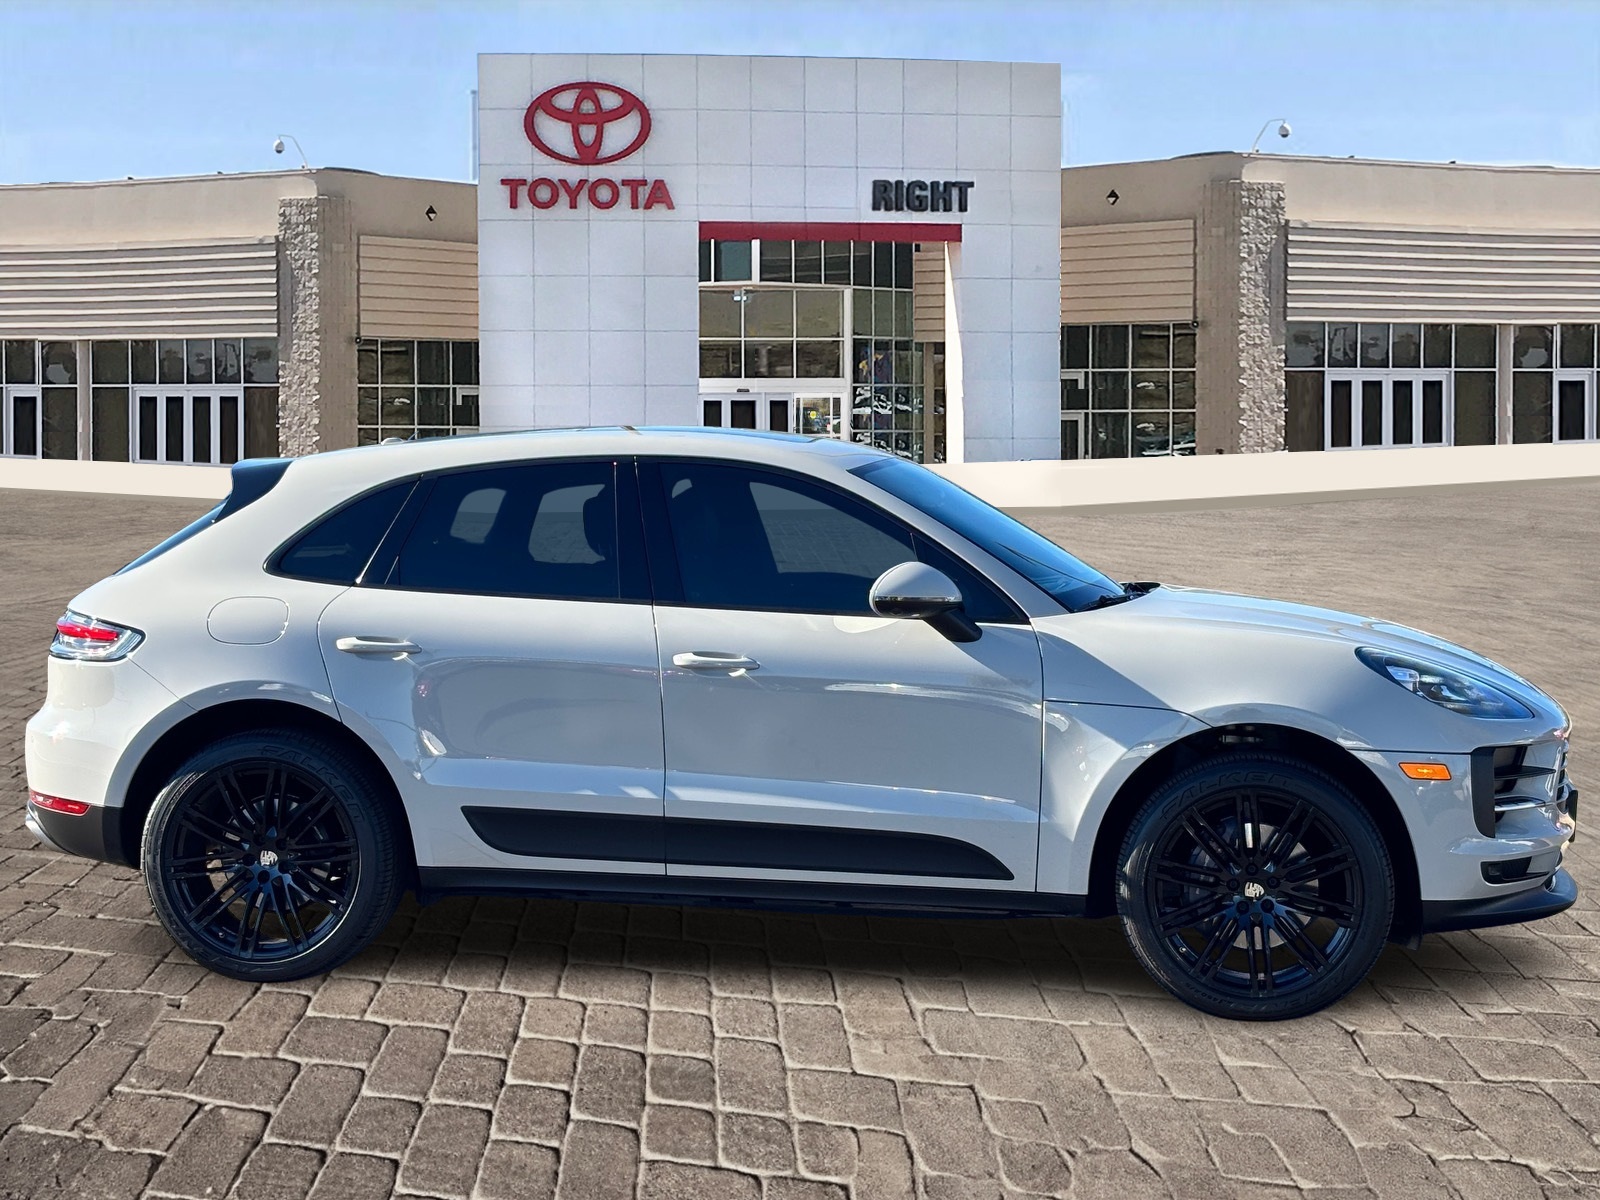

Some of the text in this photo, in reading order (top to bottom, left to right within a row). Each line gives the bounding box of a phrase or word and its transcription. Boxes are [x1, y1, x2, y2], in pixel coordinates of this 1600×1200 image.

[500, 177, 675, 209] TOYOTA
[872, 179, 975, 212] RIGHT
[257, 745, 366, 823] FALKEN
[1160, 771, 1294, 820] FALKEN
